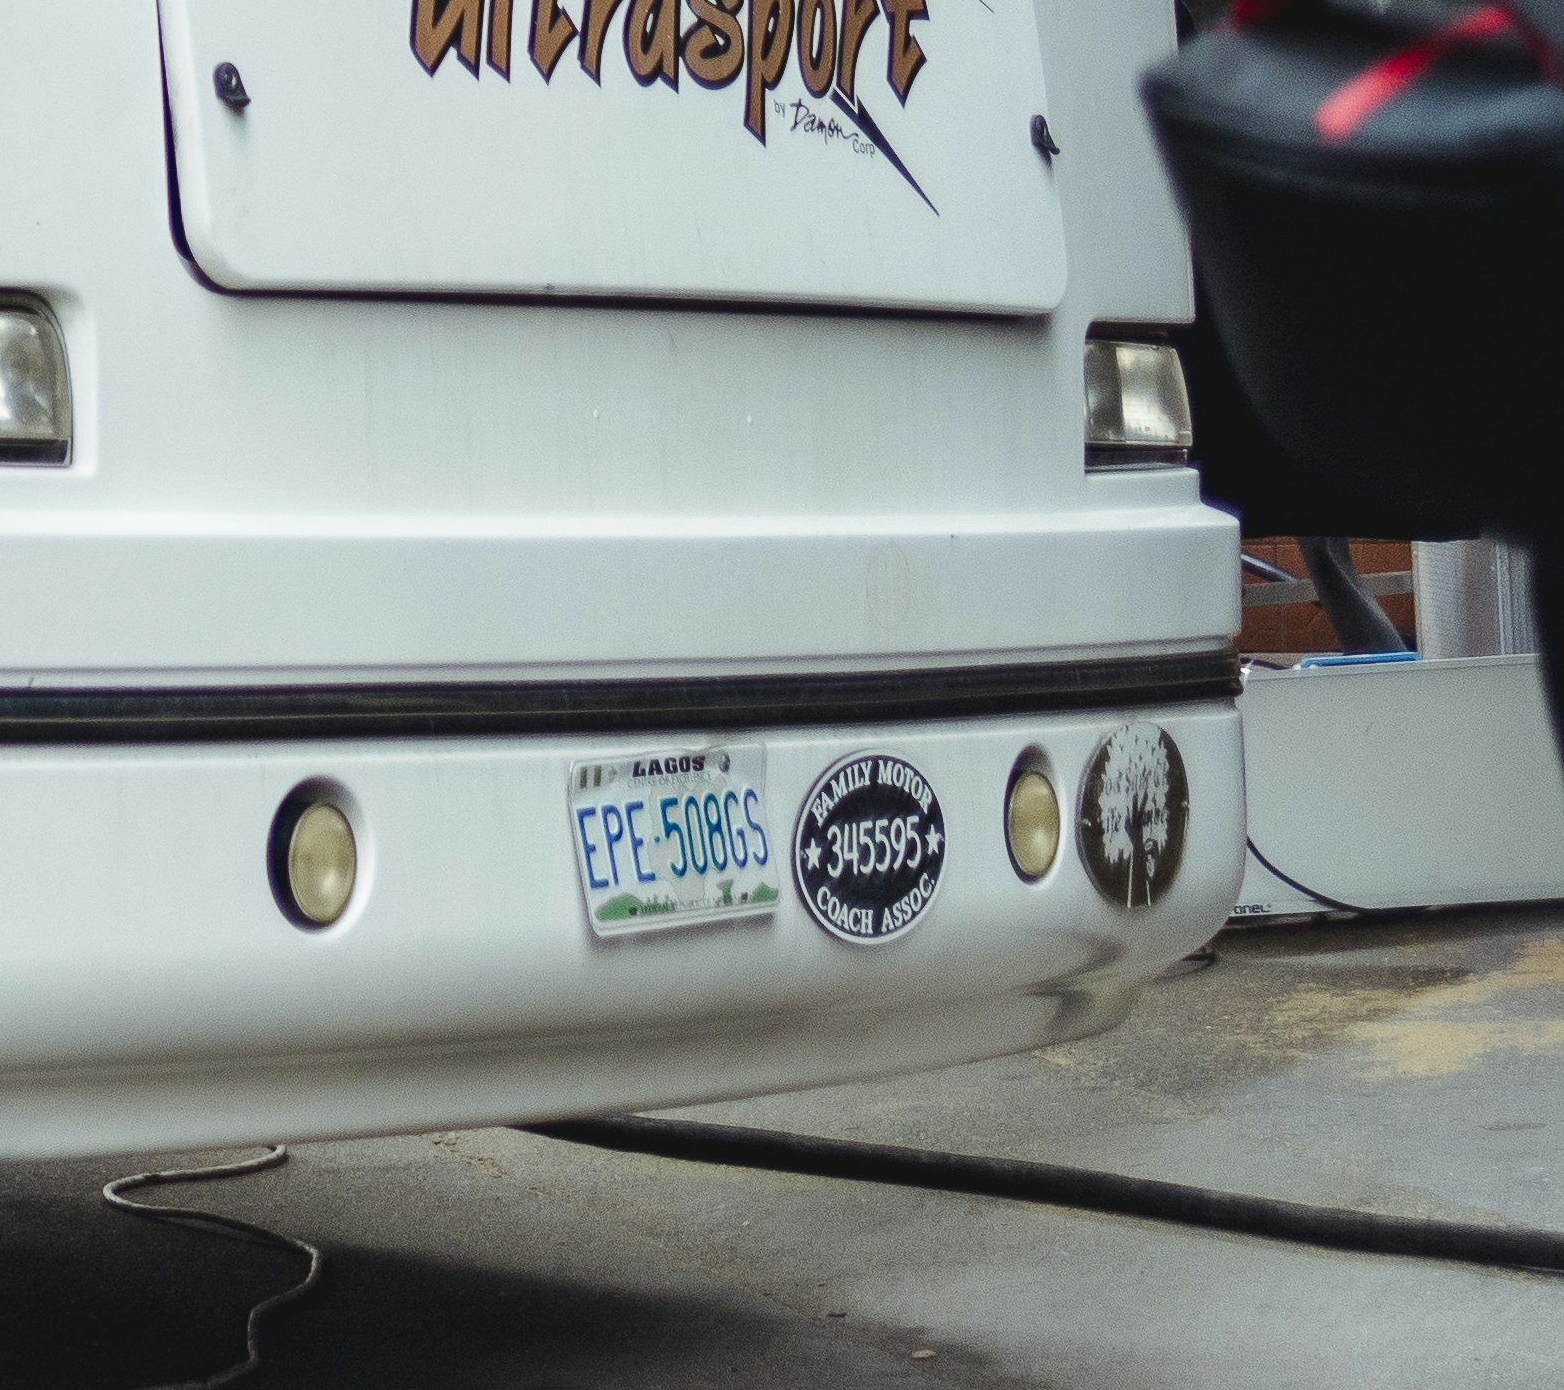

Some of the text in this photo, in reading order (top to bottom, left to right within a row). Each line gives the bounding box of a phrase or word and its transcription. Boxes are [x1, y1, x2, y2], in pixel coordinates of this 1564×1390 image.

[774, 98, 876, 158] by Damon Corp
[632, 756, 706, 778] LAGOS
[810, 759, 934, 827] FAMILY MOTOR
[825, 816, 921, 879] 345595
[816, 872, 936, 934] COACH ASSOC.
